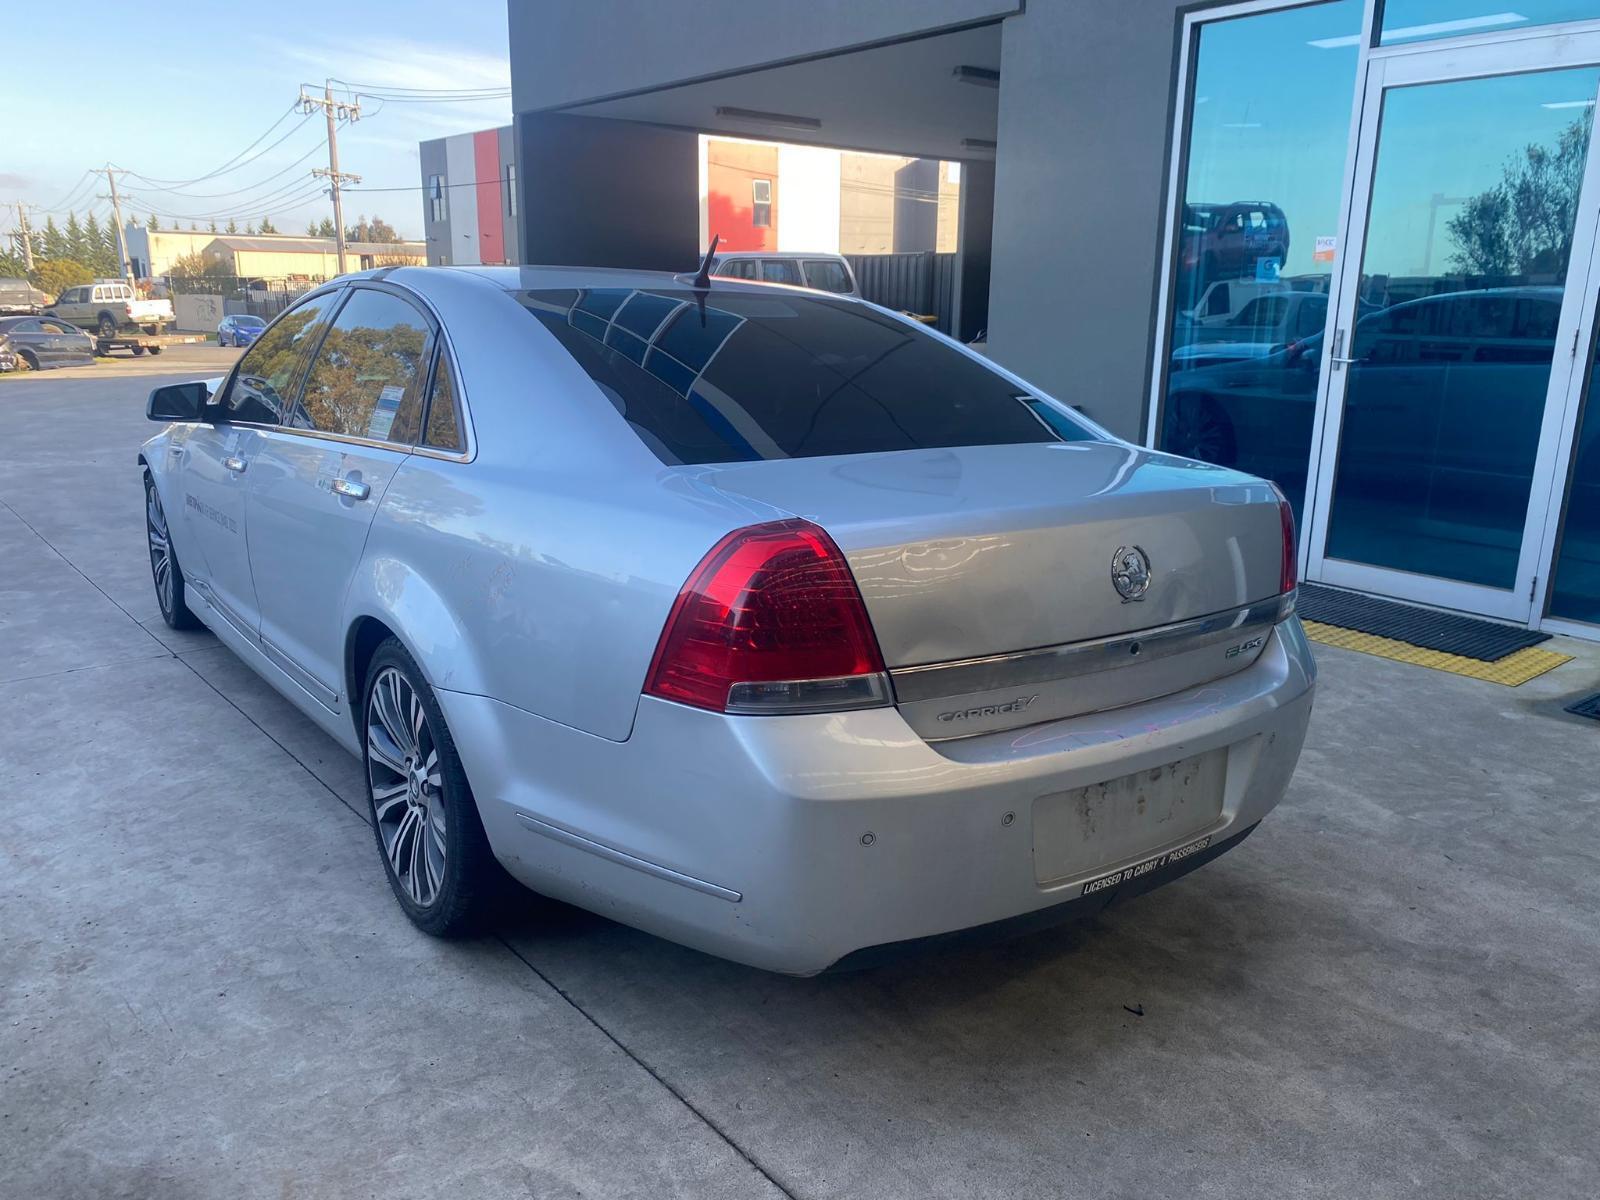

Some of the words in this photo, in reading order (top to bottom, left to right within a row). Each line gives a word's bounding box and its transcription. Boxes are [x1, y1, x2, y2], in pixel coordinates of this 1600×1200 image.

[1083, 873, 1122, 895] LICENSED
[1123, 868, 1134, 881] TO
[1133, 858, 1159, 877] CARRY
[1160, 857, 1167, 866] 4
[1168, 837, 1210, 863] PASSENGERS
